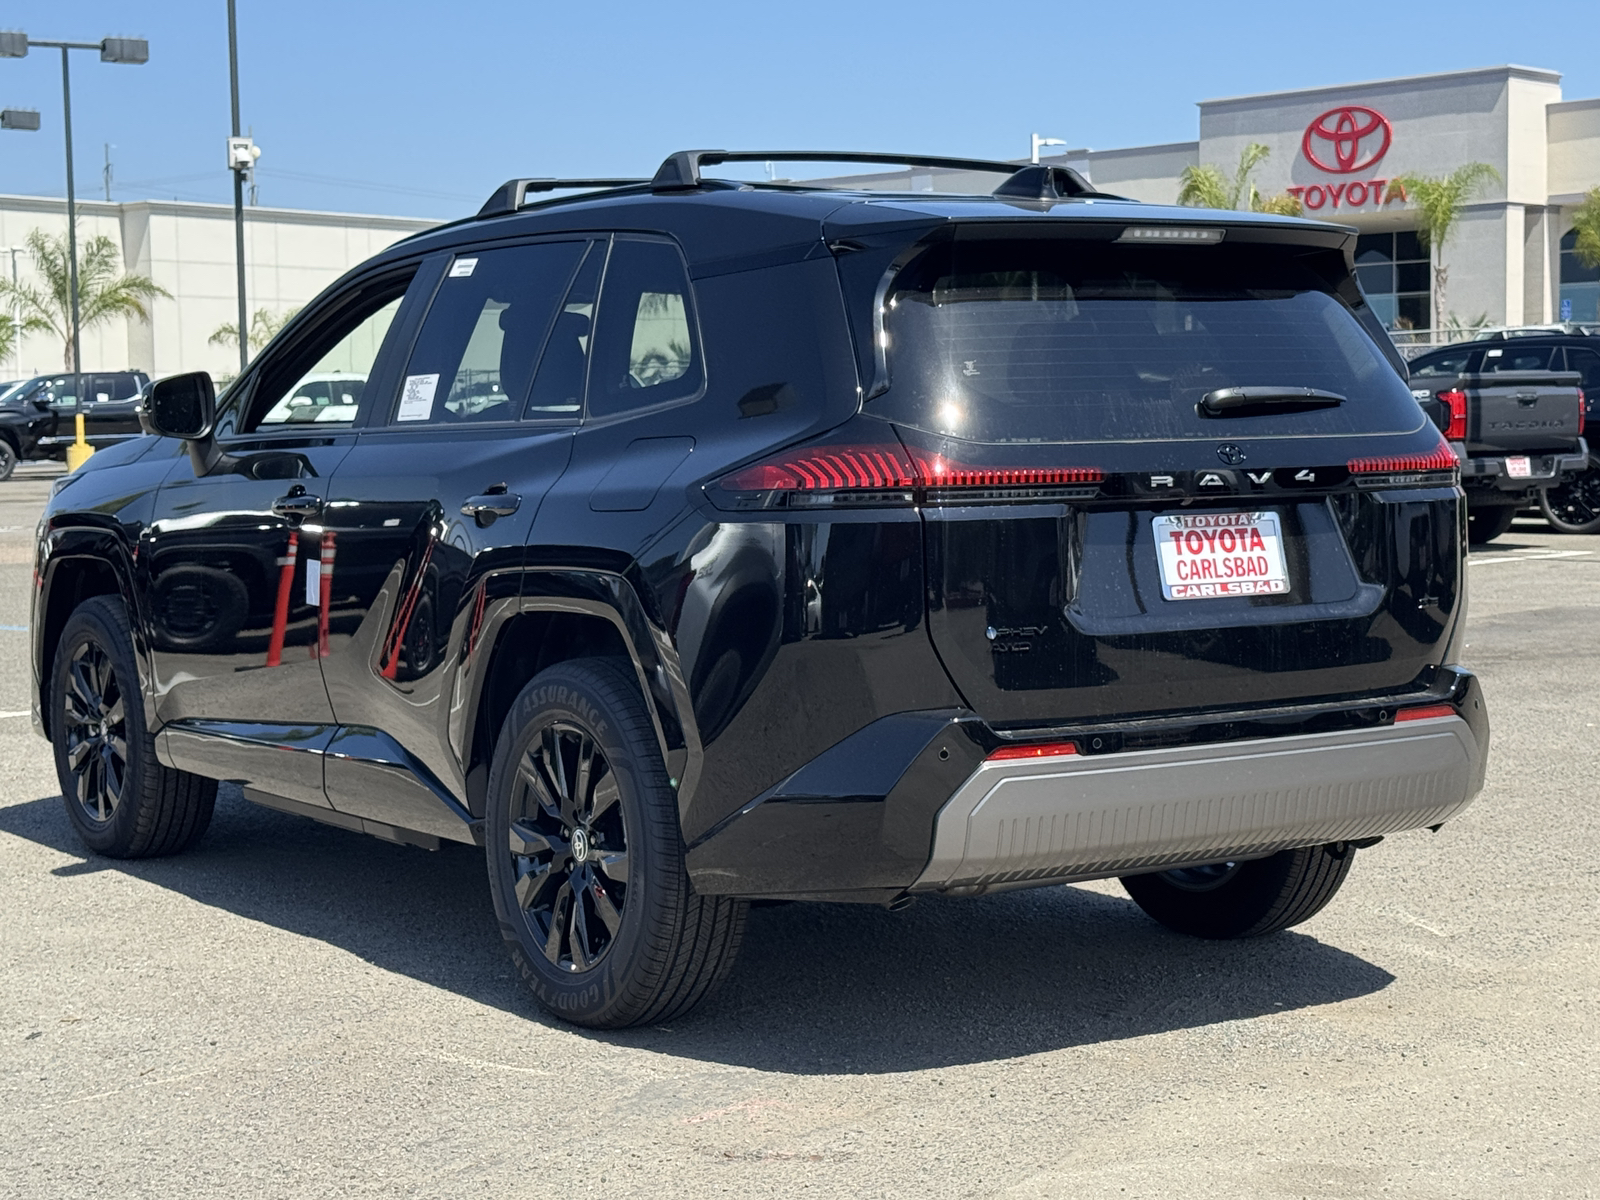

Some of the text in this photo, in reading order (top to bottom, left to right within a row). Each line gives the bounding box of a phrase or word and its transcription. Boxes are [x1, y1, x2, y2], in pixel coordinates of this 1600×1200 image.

[1487, 420, 1564, 431] TACOMA
[1150, 469, 1315, 488] RAV4
[1185, 514, 1248, 528] TOYOTA
[1170, 527, 1266, 555] TOYOTA
[1176, 556, 1269, 581] CARLSBAD
[1170, 580, 1284, 598] CARLSBAD
[522, 684, 609, 737] ASSURANCE
[511, 948, 599, 1011] GOODYEAR
